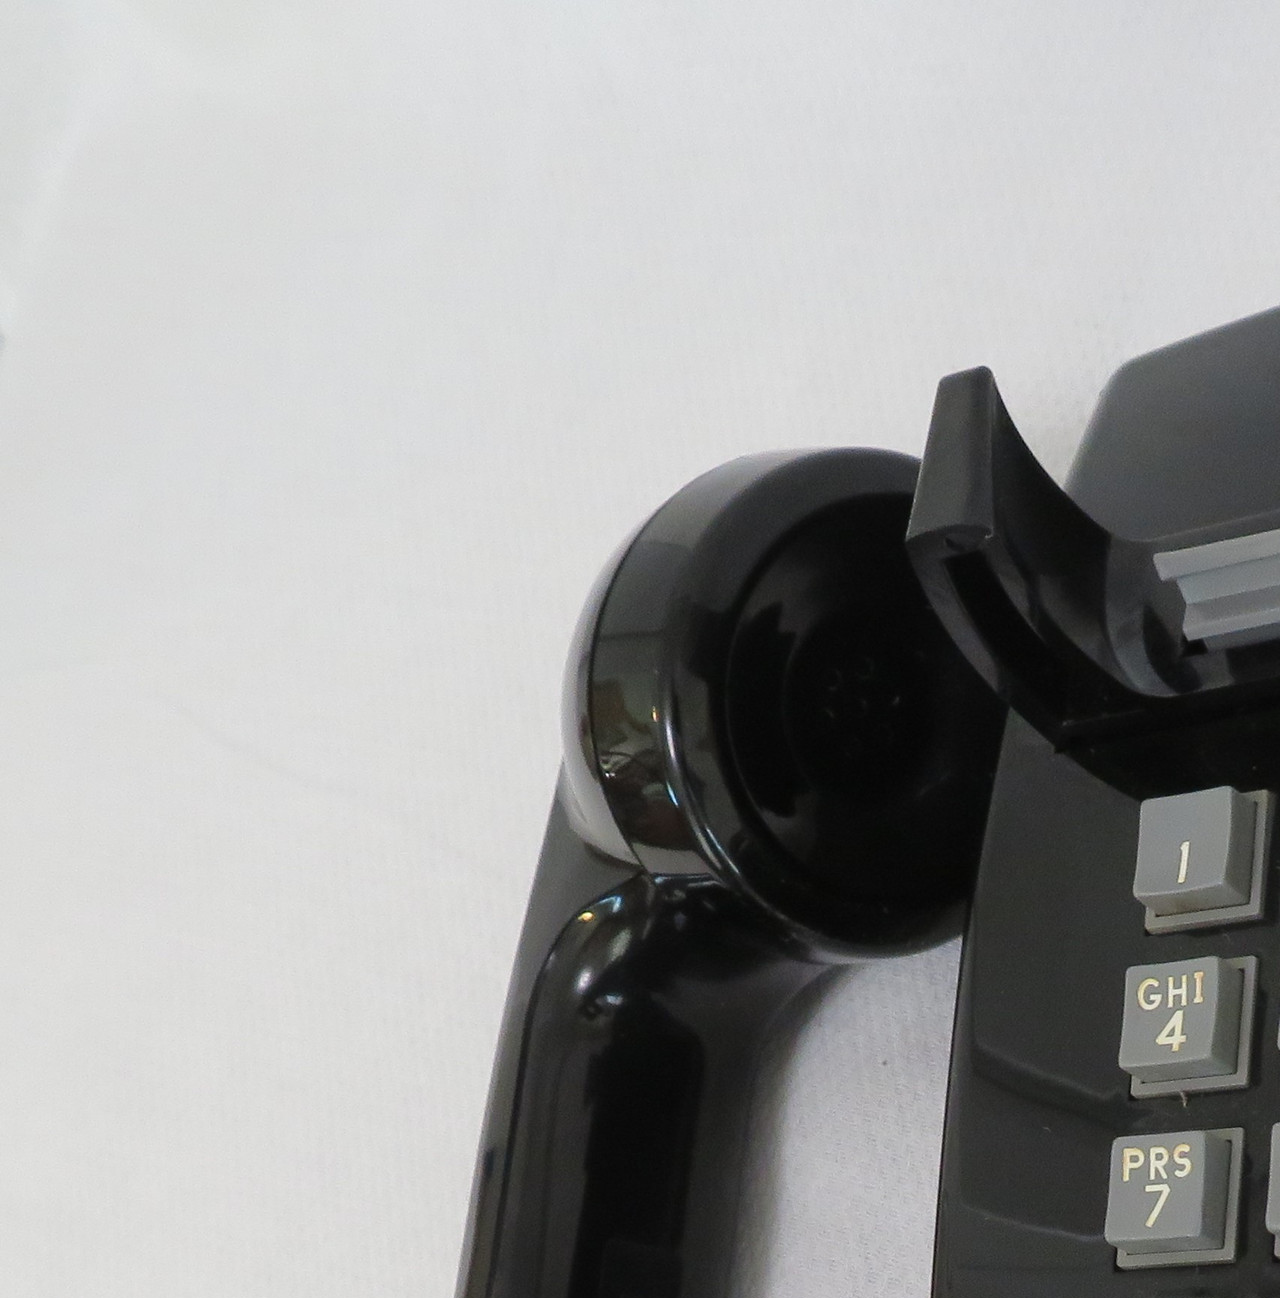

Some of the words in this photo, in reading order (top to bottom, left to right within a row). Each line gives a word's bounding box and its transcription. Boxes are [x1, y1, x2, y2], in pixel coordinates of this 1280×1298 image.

[1177, 841, 1190, 883] 1
[1137, 971, 1204, 1011] GHI
[1155, 1010, 1187, 1052] 4
[1123, 1144, 1192, 1182] PRS
[1145, 1183, 1171, 1228] 7
